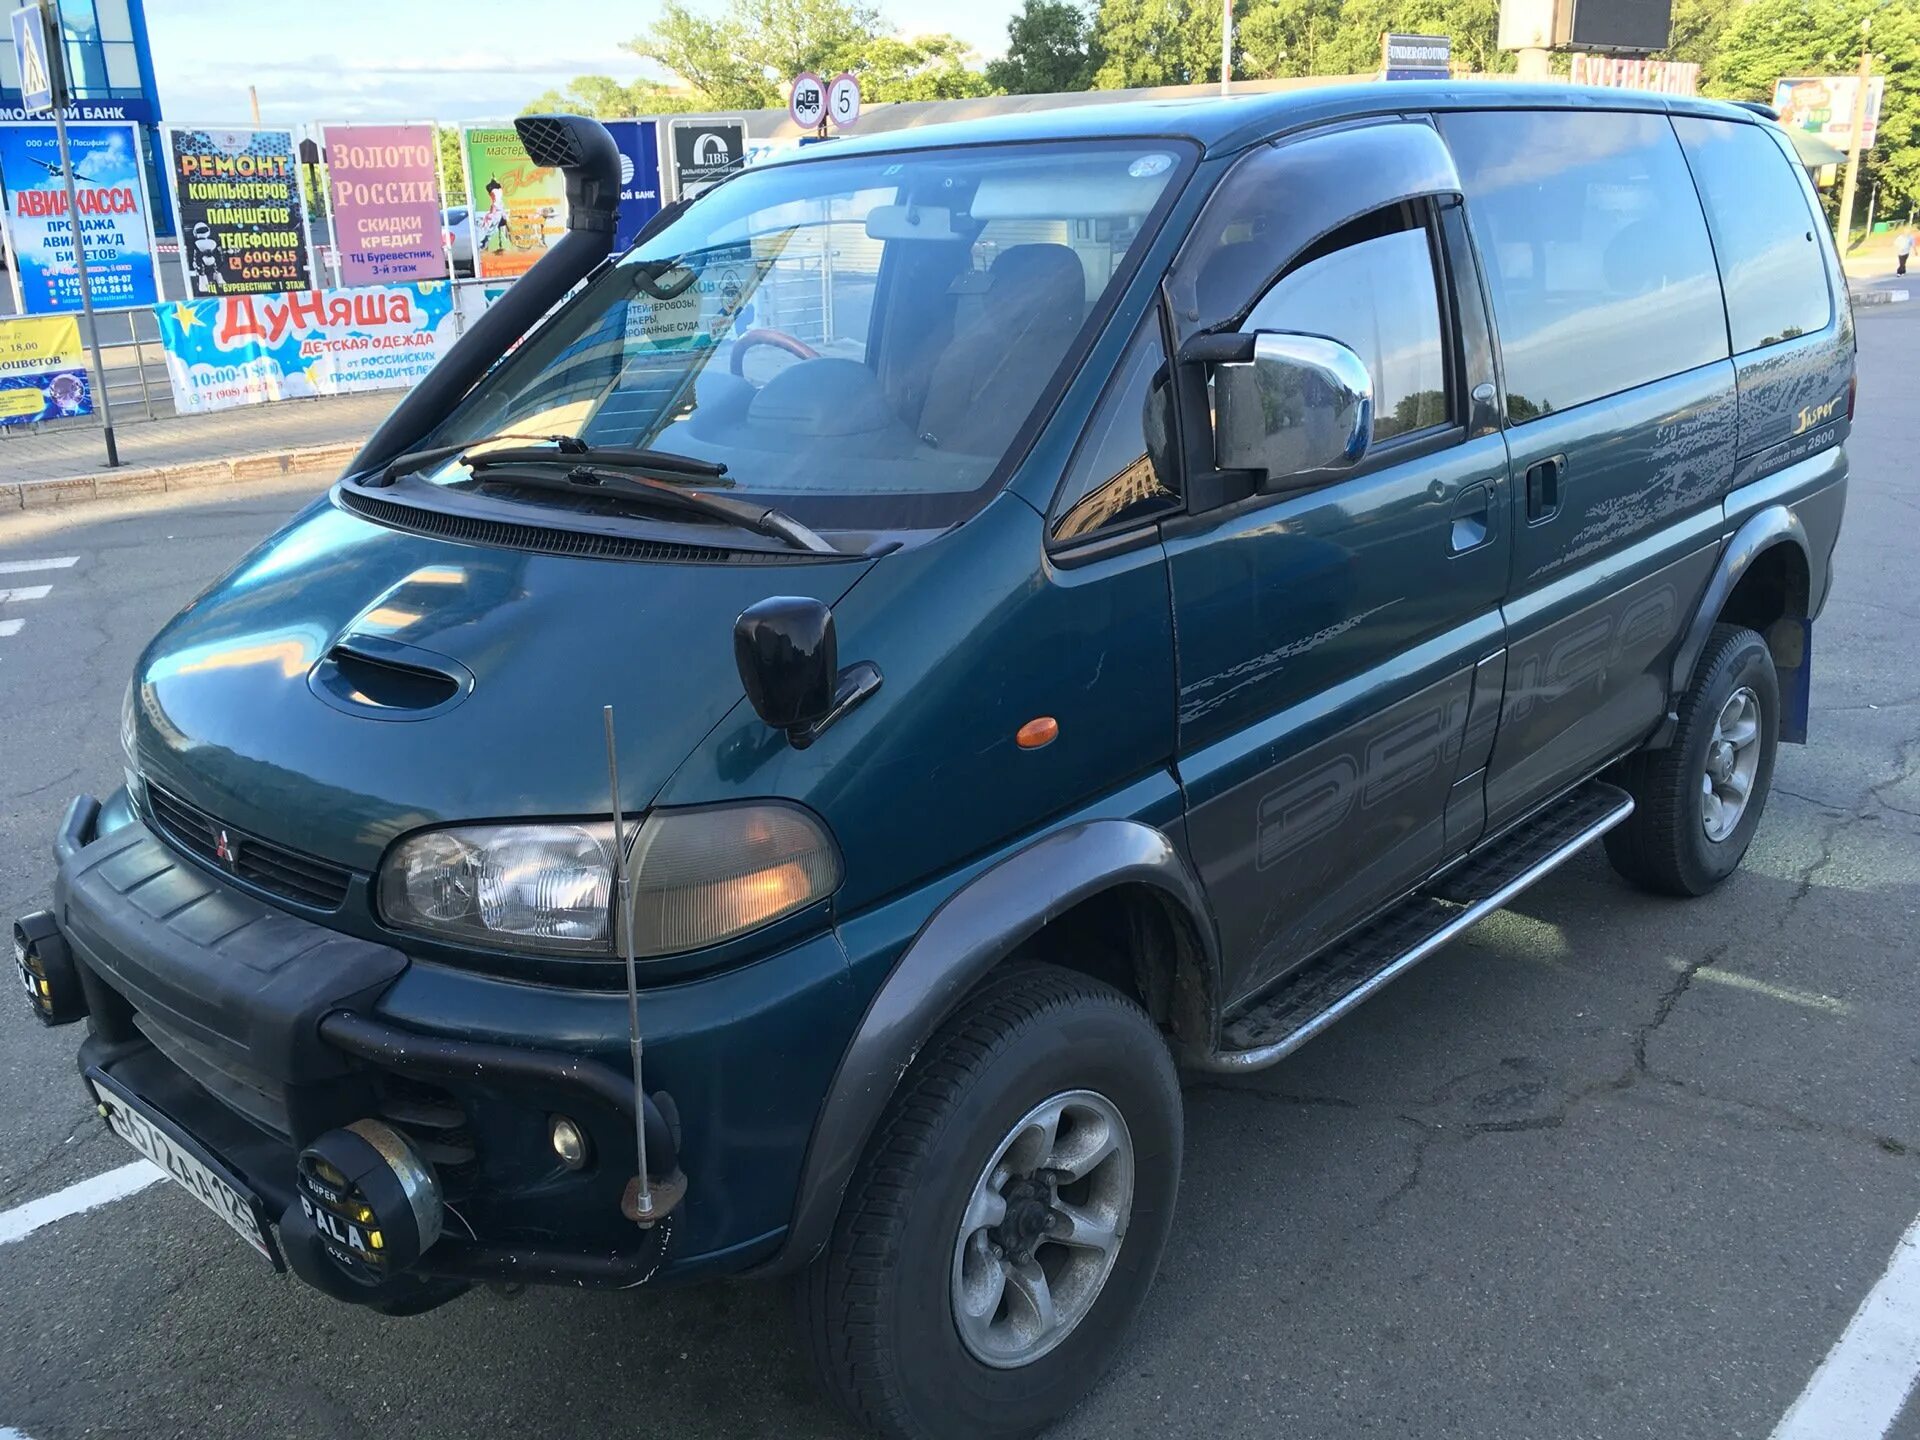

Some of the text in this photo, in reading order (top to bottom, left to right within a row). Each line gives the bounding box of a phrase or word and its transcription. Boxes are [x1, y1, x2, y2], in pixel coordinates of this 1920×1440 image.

[1390, 46, 1448, 60] UNDERGROUND
[840, 90, 850, 113] 5
[84, 107, 125, 120] БАНК
[26, 139, 42, 147] ООО
[181, 155, 288, 176] РЕМОНТ
[705, 153, 729, 166] ДВБ
[188, 183, 289, 200] КОМПЬЮТЕРОВ
[635, 190, 655, 199] БАНК
[18, 187, 138, 217] АВИАКАССА
[206, 208, 290, 224] ПЛАНШЕТОВ
[47, 219, 115, 232] ПРОДАЖА
[358, 216, 421, 233] СКИДКИ
[97, 233, 125, 246] Ж/Д
[218, 231, 299, 249] ТЕЛЕФОНОВ
[361, 233, 422, 249] КРЕДИТ
[56, 250, 117, 262] БИЕТОВ
[244, 250, 297, 263] 600-615
[350, 253, 365, 264] ТЦ
[367, 250, 435, 264] Буревестник,
[242, 265, 297, 279] 60-50-12
[372, 264, 417, 275] 3-й этаж
[218, 281, 277, 293] "БУРЕВЕСТНИК"
[286, 280, 306, 290] ЭТАЖ
[626, 315, 658, 327] ЛКЕРЫ,
[677, 321, 700, 332] СУДА
[10, 342, 38, 352] 18.00
[302, 333, 434, 355] ДЕТСКАЯ ОДЕЖДА
[0, 351, 68, 370] оцветов"
[361, 351, 435, 366] РОССИЙСКИХ
[330, 364, 434, 383] ПРОИЗВОДИТЕЛЕ
[1807, 429, 1835, 450] 2800
[308, 1180, 337, 1203] SUPER
[300, 1195, 366, 1252] PALA
